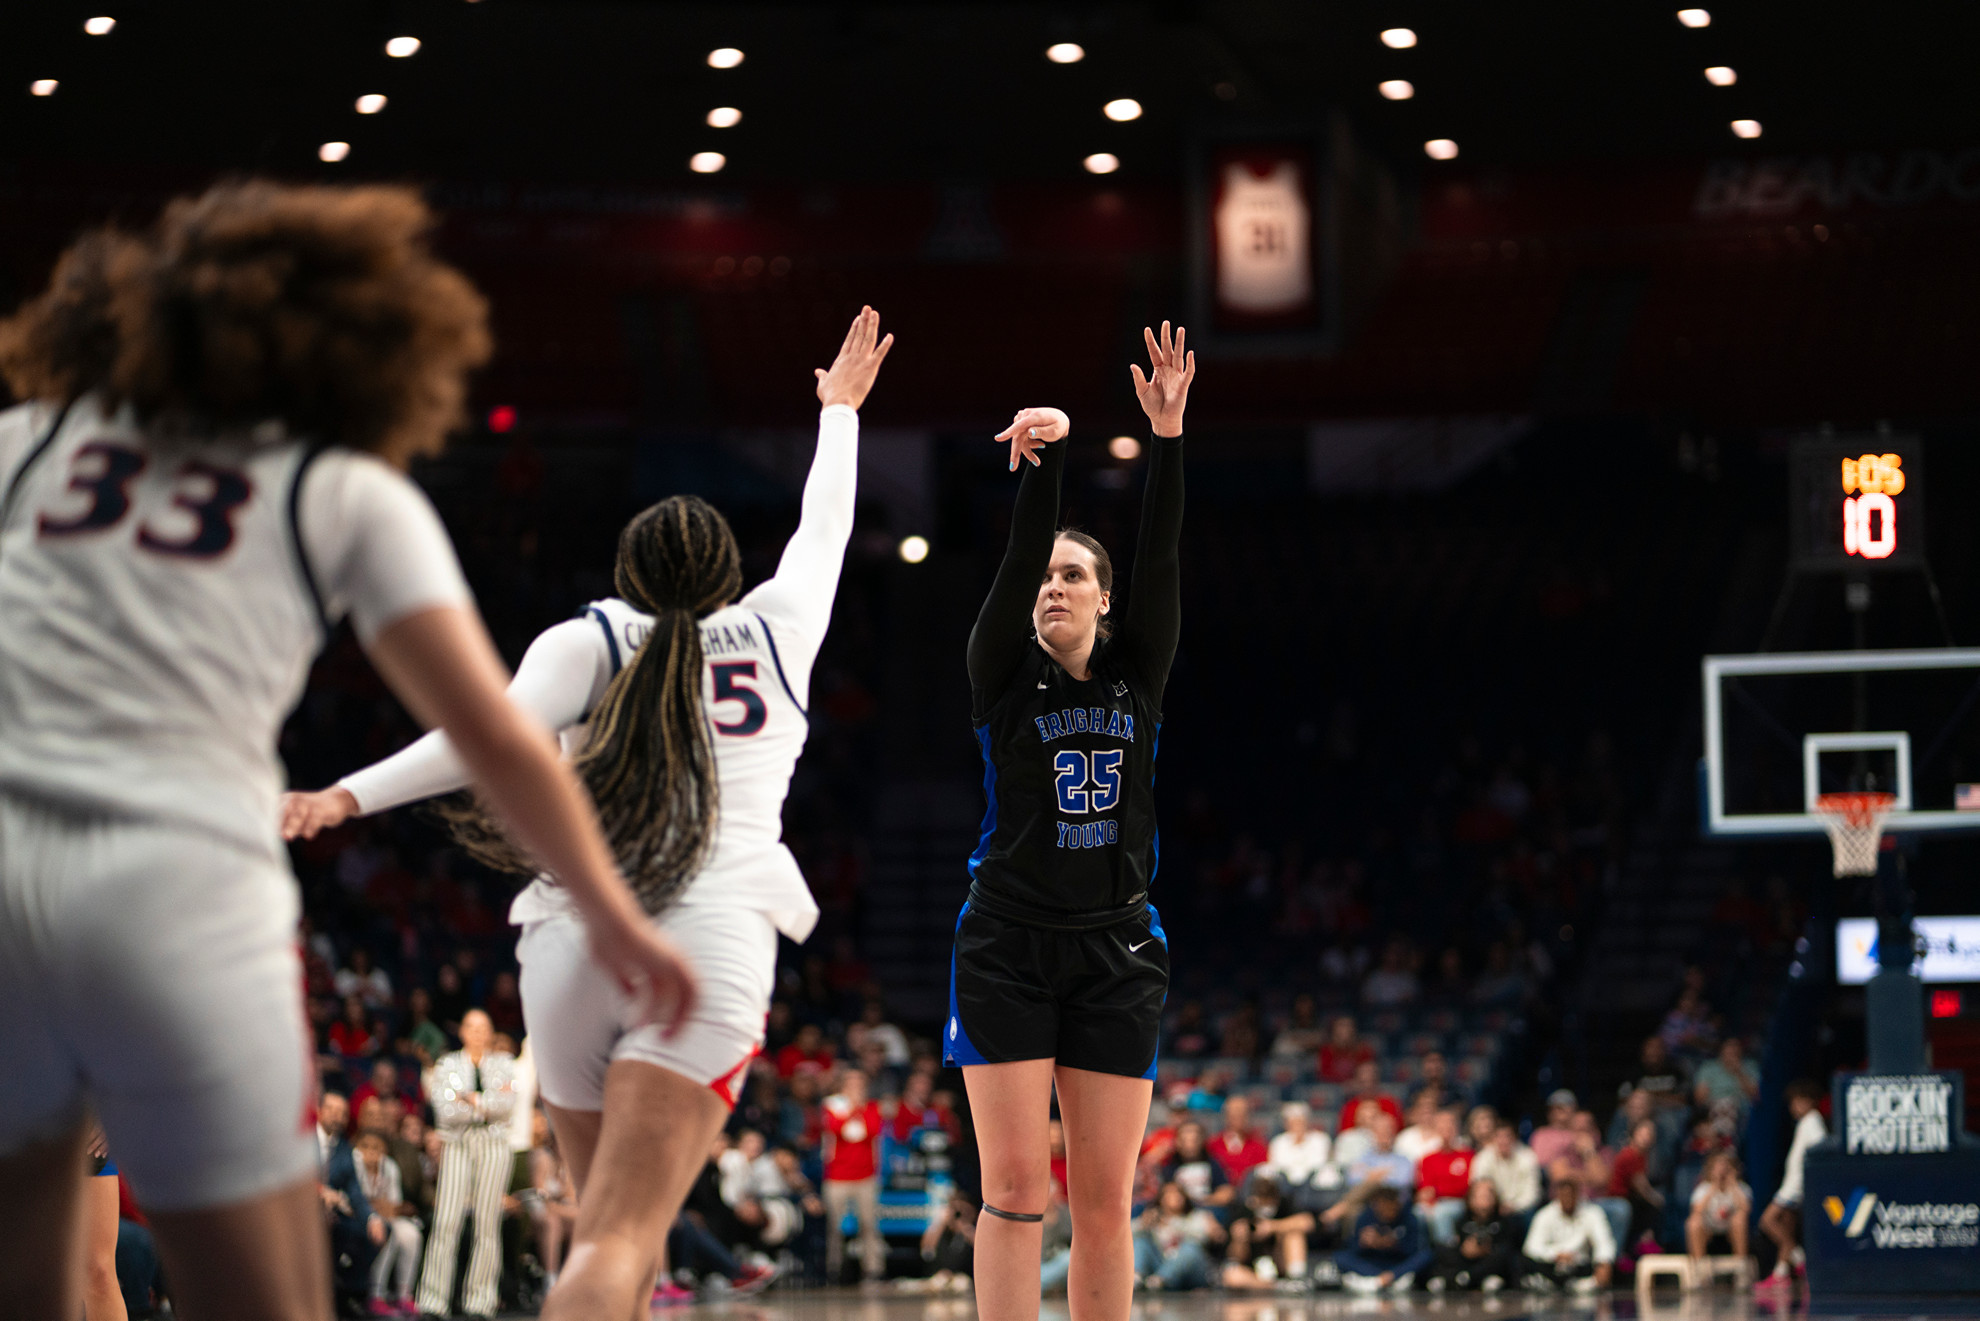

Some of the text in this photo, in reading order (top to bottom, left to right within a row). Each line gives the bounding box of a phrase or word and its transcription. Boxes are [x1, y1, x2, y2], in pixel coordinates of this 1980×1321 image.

[35, 440, 256, 560] 33
[1843, 492, 1897, 560] 10
[1053, 749, 1123, 814] 25
[1056, 819, 1118, 849] YOUNG
[1846, 1117, 1949, 1155] PROTEIN
[1874, 1200, 1980, 1227] Vantage
[1872, 1223, 1936, 1249] West
